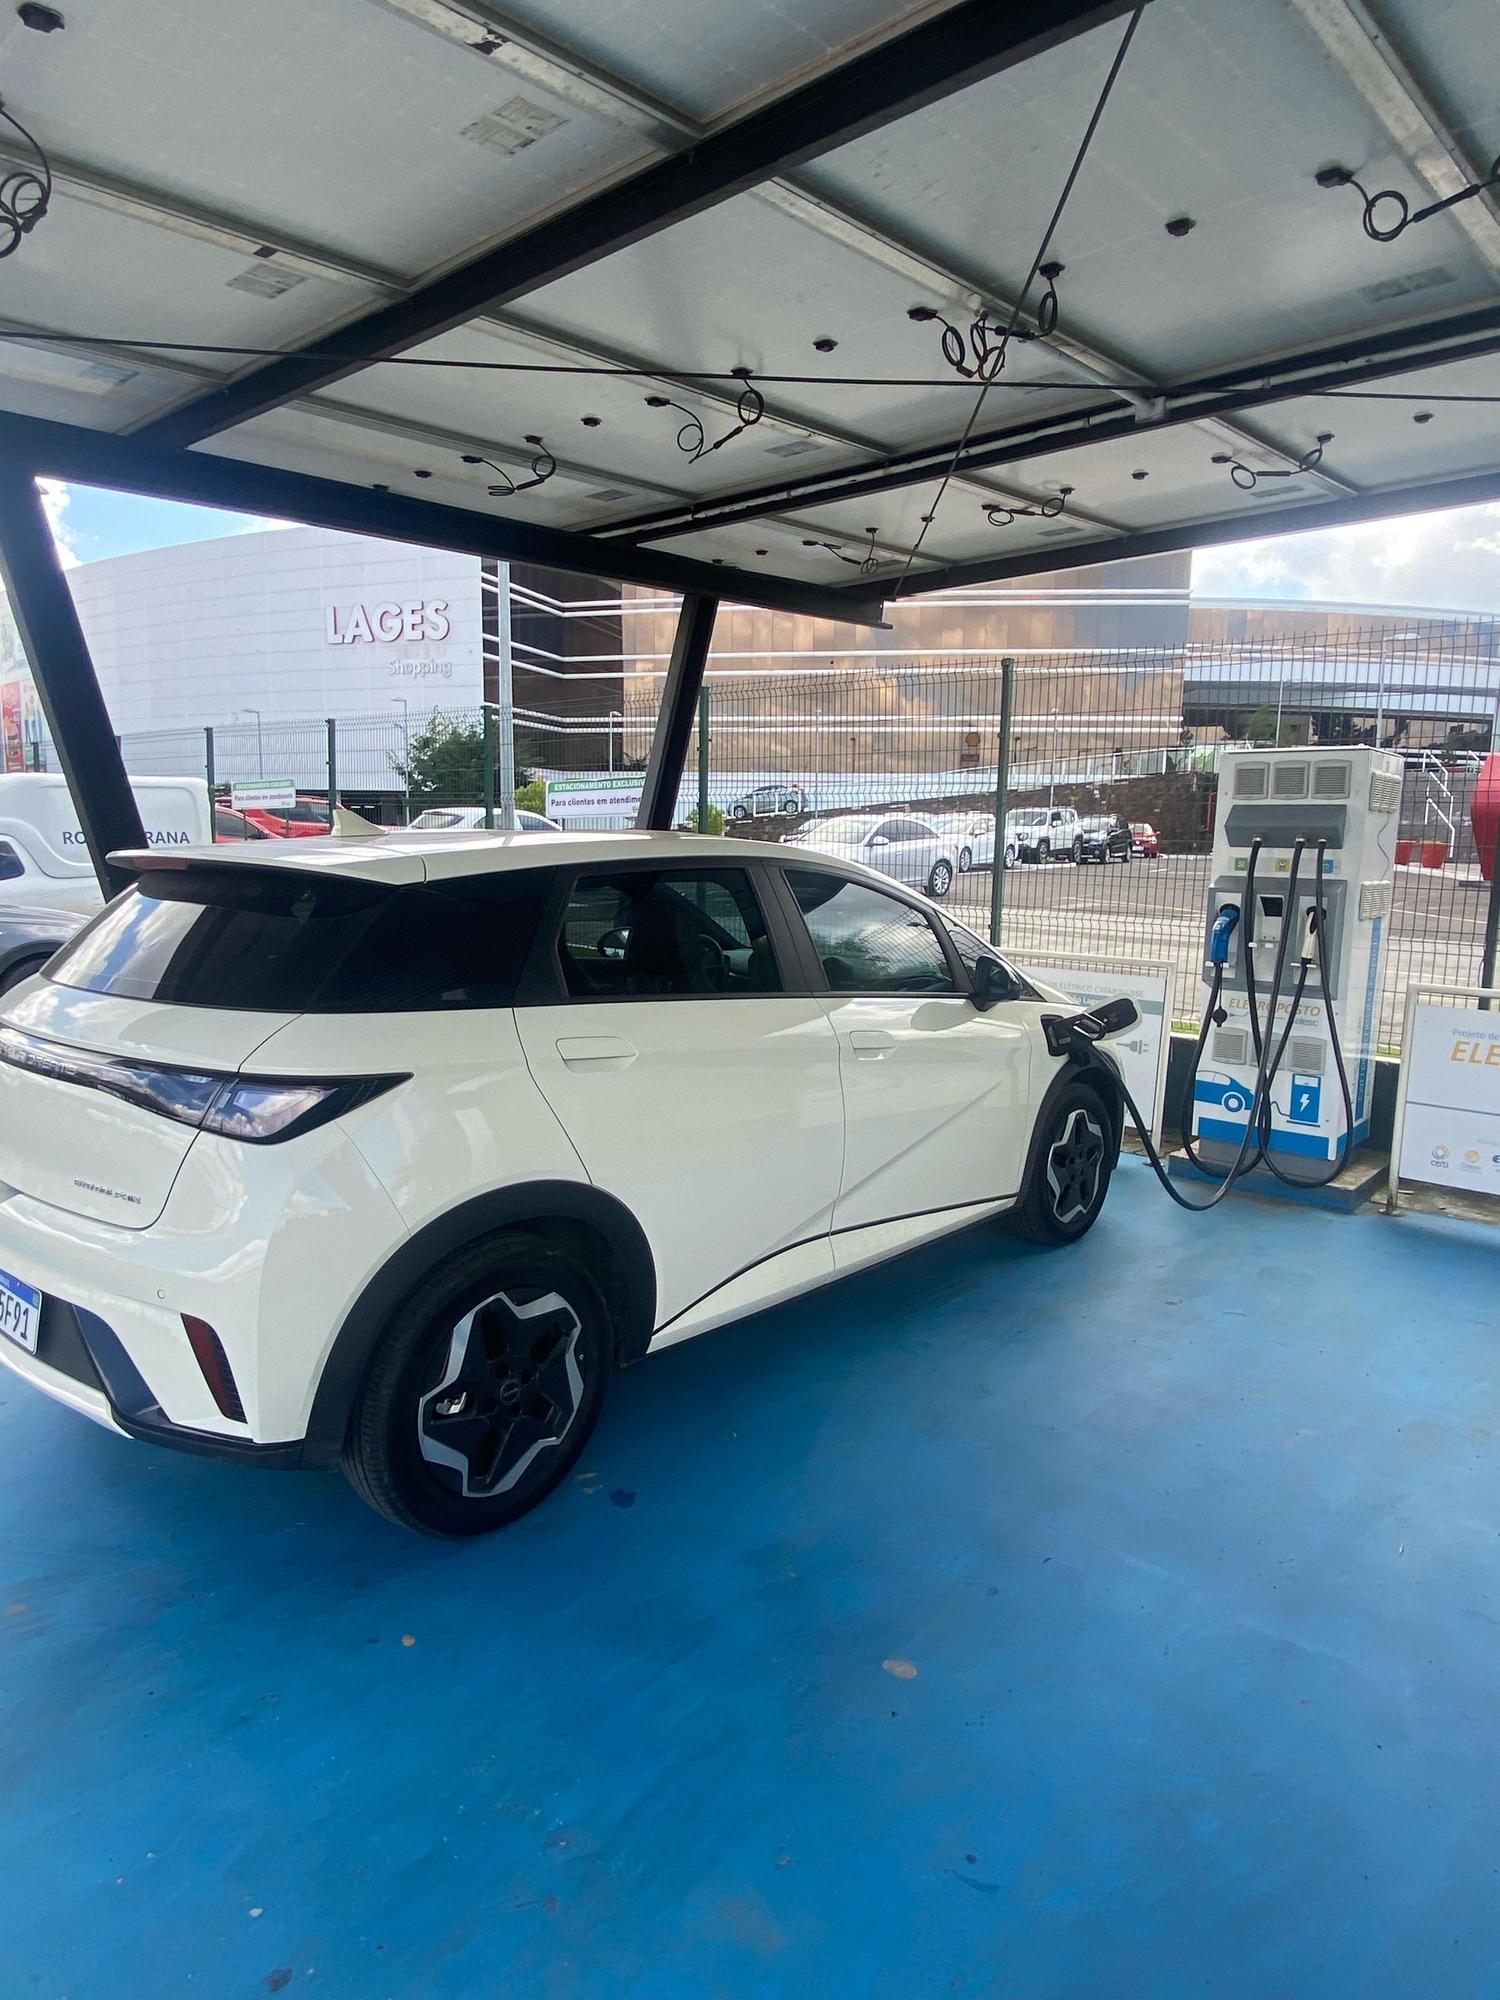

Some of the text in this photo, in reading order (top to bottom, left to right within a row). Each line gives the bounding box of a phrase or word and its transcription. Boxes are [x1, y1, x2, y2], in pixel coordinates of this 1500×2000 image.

[326, 599, 450, 645] LAGES
[388, 659, 453, 678] Shopping
[554, 777, 645, 791] ESTACIONAMENTO EXCLUSIV
[551, 799, 566, 807] Para
[567, 797, 595, 806] clientes
[609, 796, 641, 805] atendime
[1452, 1029, 1485, 1040] Projeto
